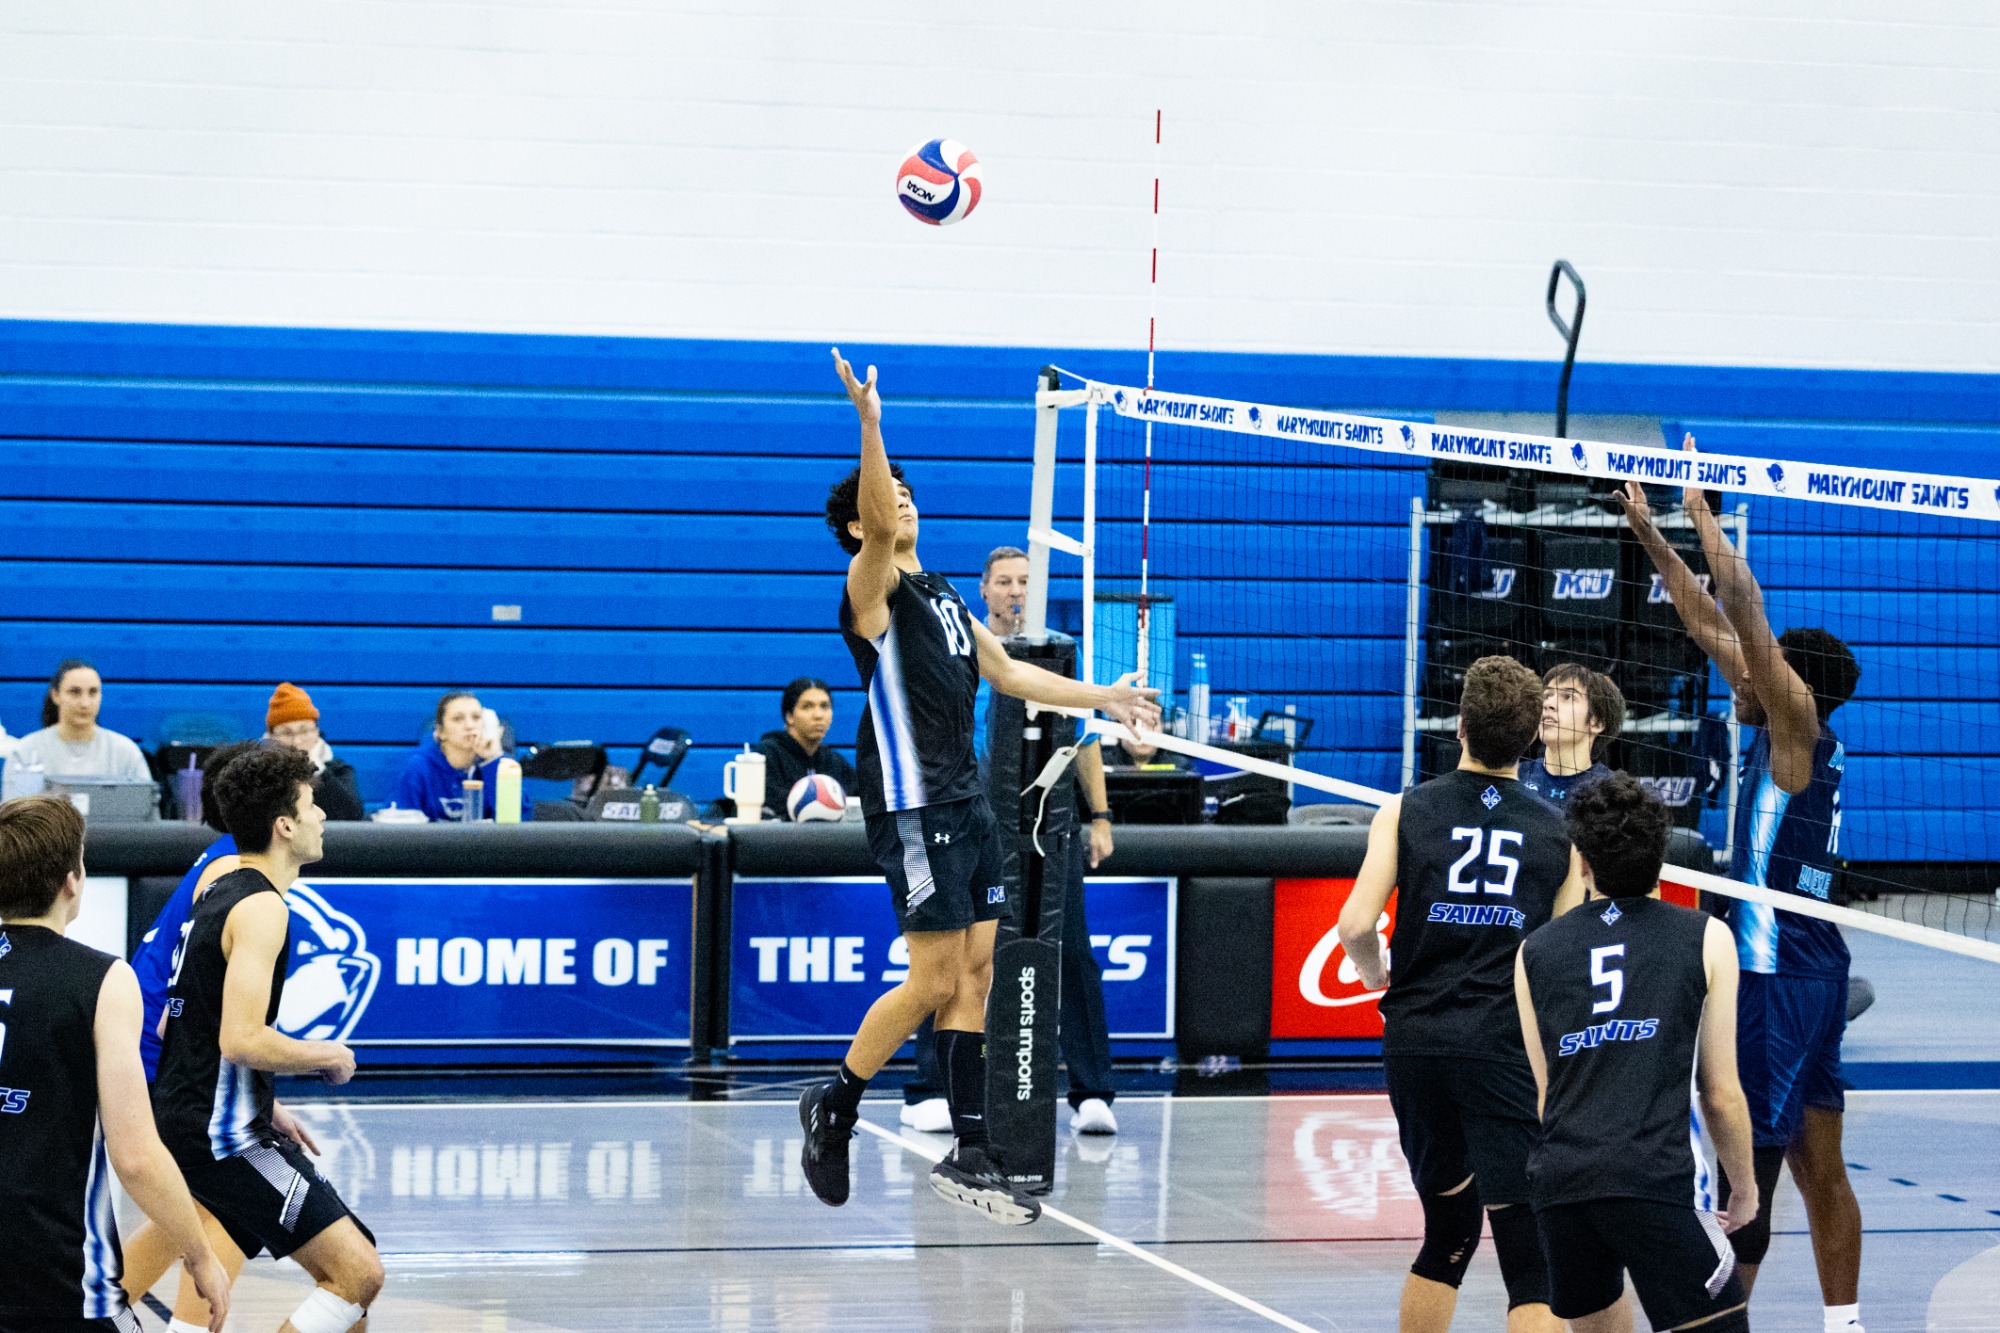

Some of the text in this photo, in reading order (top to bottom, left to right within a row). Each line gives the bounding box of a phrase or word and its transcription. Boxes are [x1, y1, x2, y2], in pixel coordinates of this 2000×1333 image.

[906, 180, 935, 202] NCAA
[1136, 397, 1235, 425] MARYMOUNT SAINTS
[1277, 413, 1384, 445] MARYMOUNT SAINTS
[1431, 431, 1552, 465] MARYMOUNT SAINTS
[1607, 451, 1747, 487] MARYMOUNT SAINTS
[1807, 472, 1970, 511] MARYMOUNT SAINTS
[930, 598, 972, 656] 10
[1448, 827, 1524, 896] 25
[1427, 902, 1527, 929] SAINTS
[396, 937, 669, 987] HOME OF
[749, 936, 865, 983] THE
[1590, 942, 1625, 1015] 5
[1016, 966, 1036, 1101] sports imports
[1558, 1018, 1660, 1057] SAINTS
